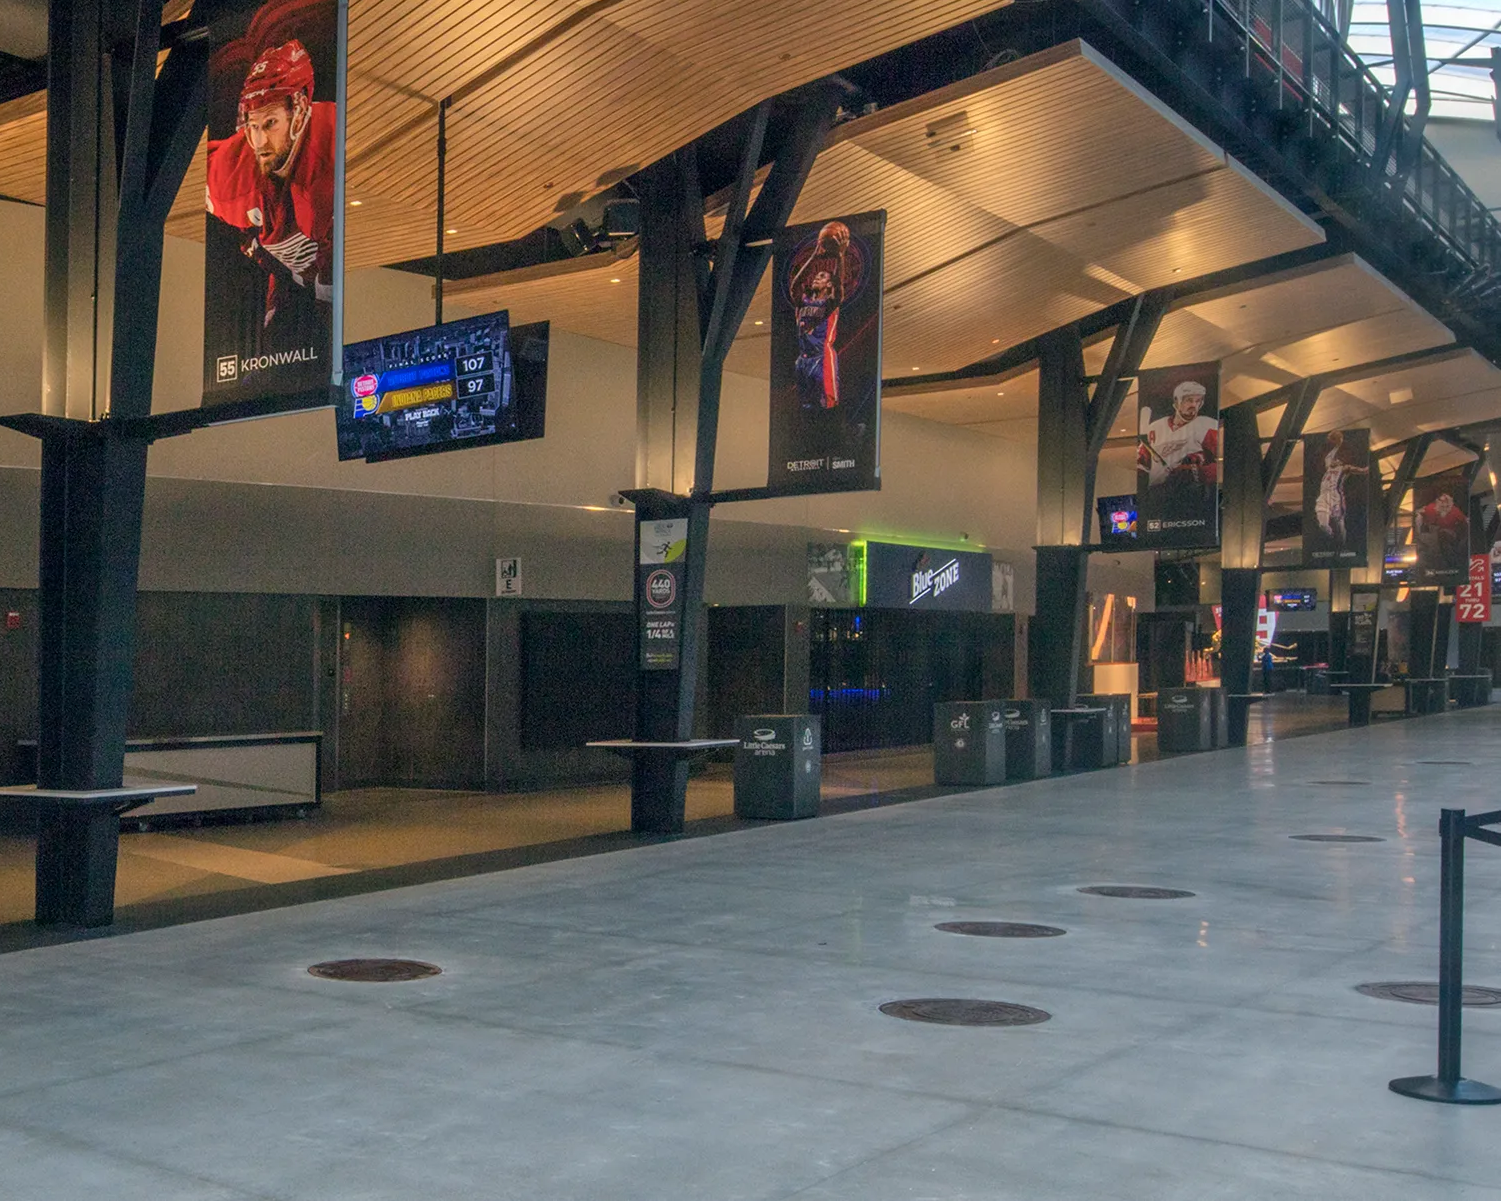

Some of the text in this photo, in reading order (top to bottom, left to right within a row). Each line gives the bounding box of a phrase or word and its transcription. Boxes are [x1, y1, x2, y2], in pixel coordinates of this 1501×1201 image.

[219, 347, 318, 377] 55 KRONWALL
[462, 356, 485, 371] 107
[467, 378, 484, 393] 97
[392, 384, 453, 407] INDIANA PACERS
[787, 459, 824, 470] DETROIT
[832, 459, 855, 470] SMITH
[1162, 519, 1206, 529] ERICSSON
[652, 579, 670, 588] 440
[911, 568, 934, 598] Blue
[933, 562, 960, 598] ZONE
[1459, 582, 1483, 597] 21
[1459, 603, 1485, 619] 72
[951, 715, 970, 729] GFL
